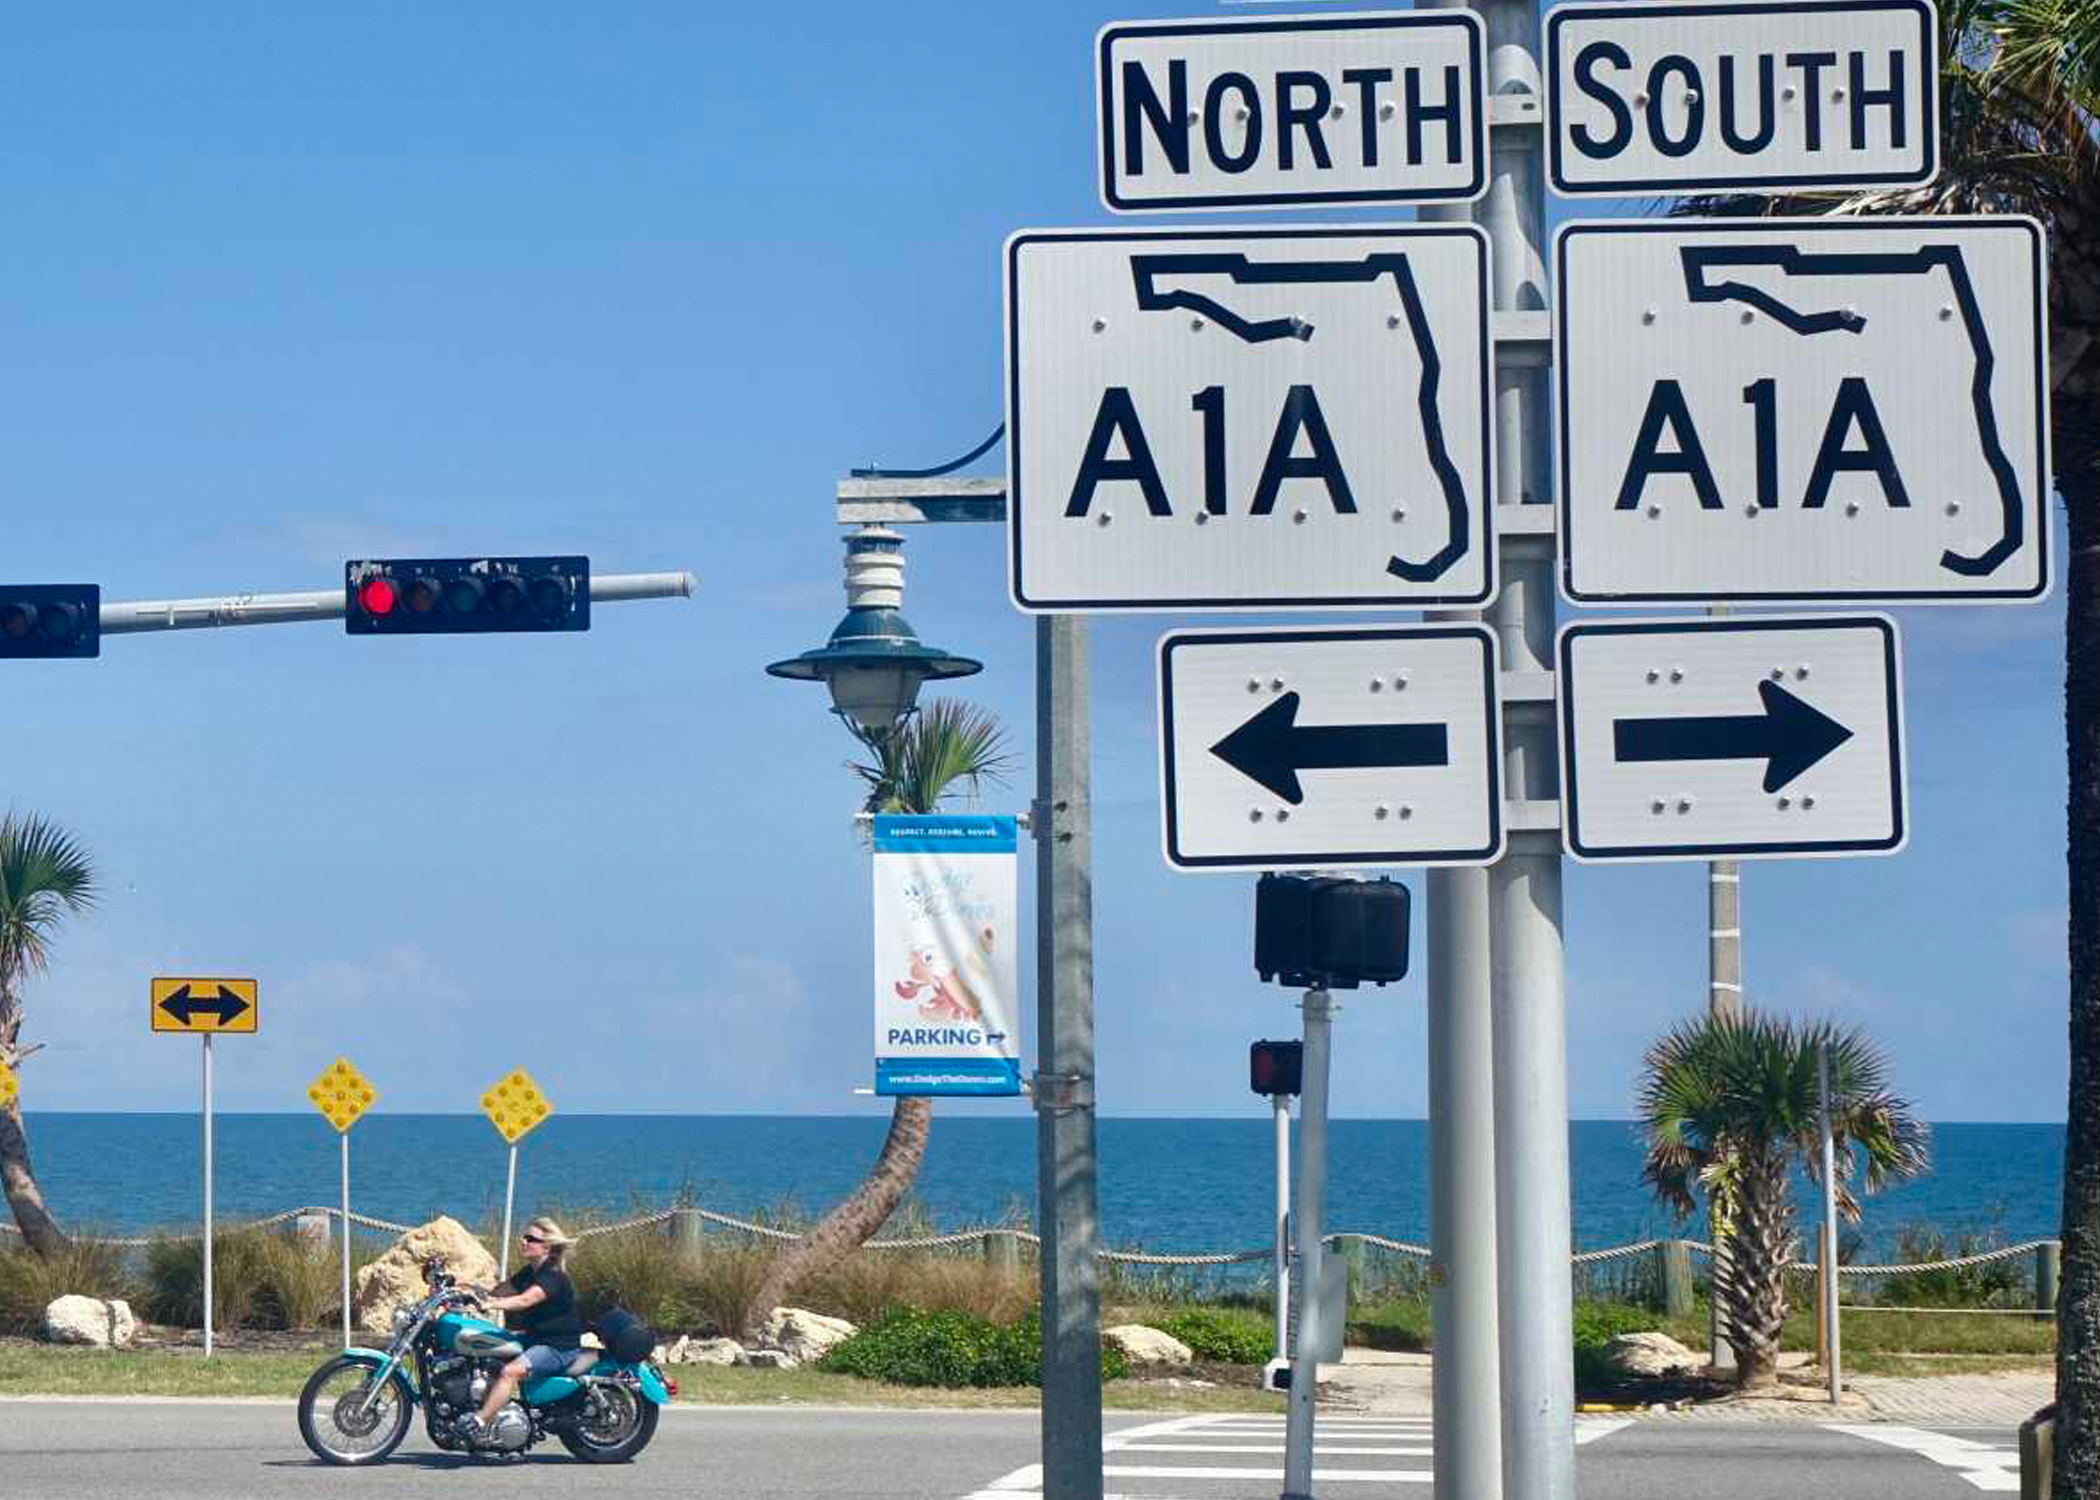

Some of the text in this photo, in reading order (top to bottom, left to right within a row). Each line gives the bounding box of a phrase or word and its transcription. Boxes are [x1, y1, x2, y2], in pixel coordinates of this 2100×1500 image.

[1122, 59, 1462, 176] NORTH
[1569, 40, 1906, 160] SOUTH
[1064, 384, 1358, 518] A1A
[1614, 377, 1911, 511] A1A
[888, 1028, 982, 1046] PARKING
